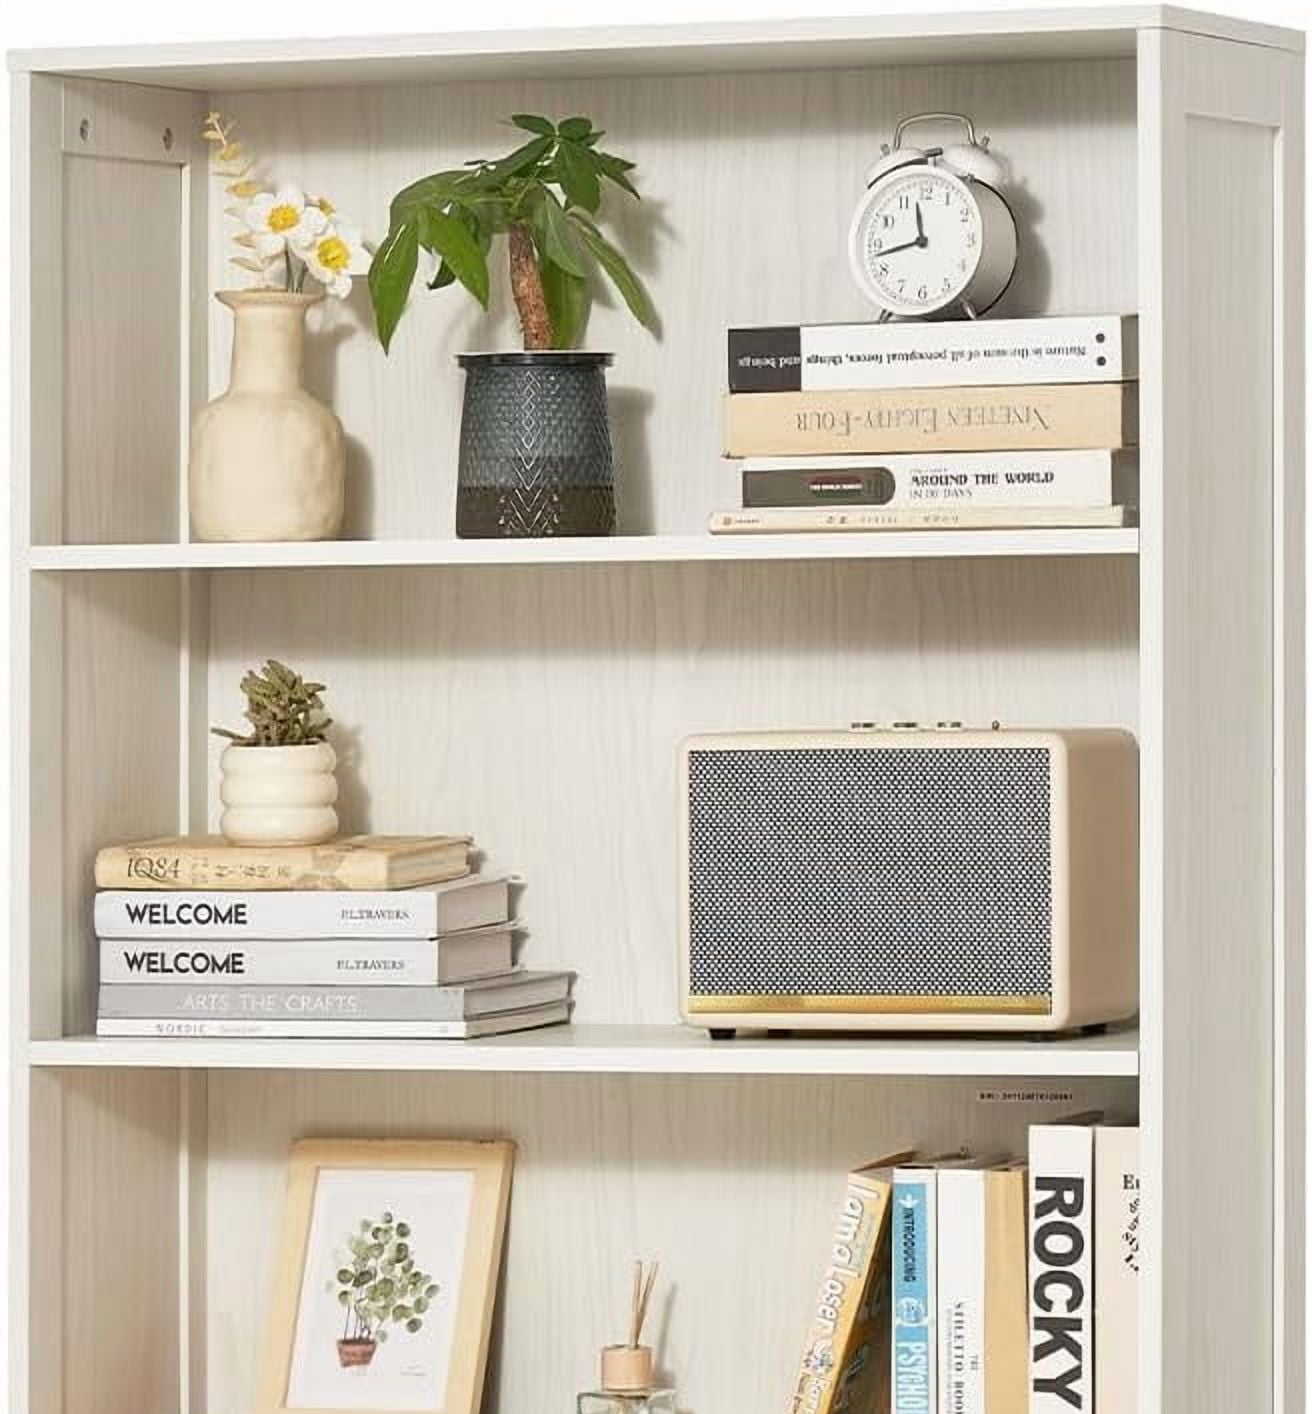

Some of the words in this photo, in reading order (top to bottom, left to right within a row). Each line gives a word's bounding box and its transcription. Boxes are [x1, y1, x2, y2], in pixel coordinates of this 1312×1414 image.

[806, 353, 843, 367] things
[911, 474, 969, 487] AROUND
[974, 473, 999, 485] THE
[1005, 471, 1055, 485] WORLD
[125, 903, 248, 925] WELCOME
[123, 951, 246, 974] WELCOME
[181, 993, 230, 1011] ARTS
[238, 993, 276, 1011] THE
[284, 994, 359, 1013] CRAFTS
[903, 1207, 916, 1283] INTRODUCING
[1032, 1176, 1086, 1410] ROCKY
[954, 1301, 965, 1371] STILETTO
